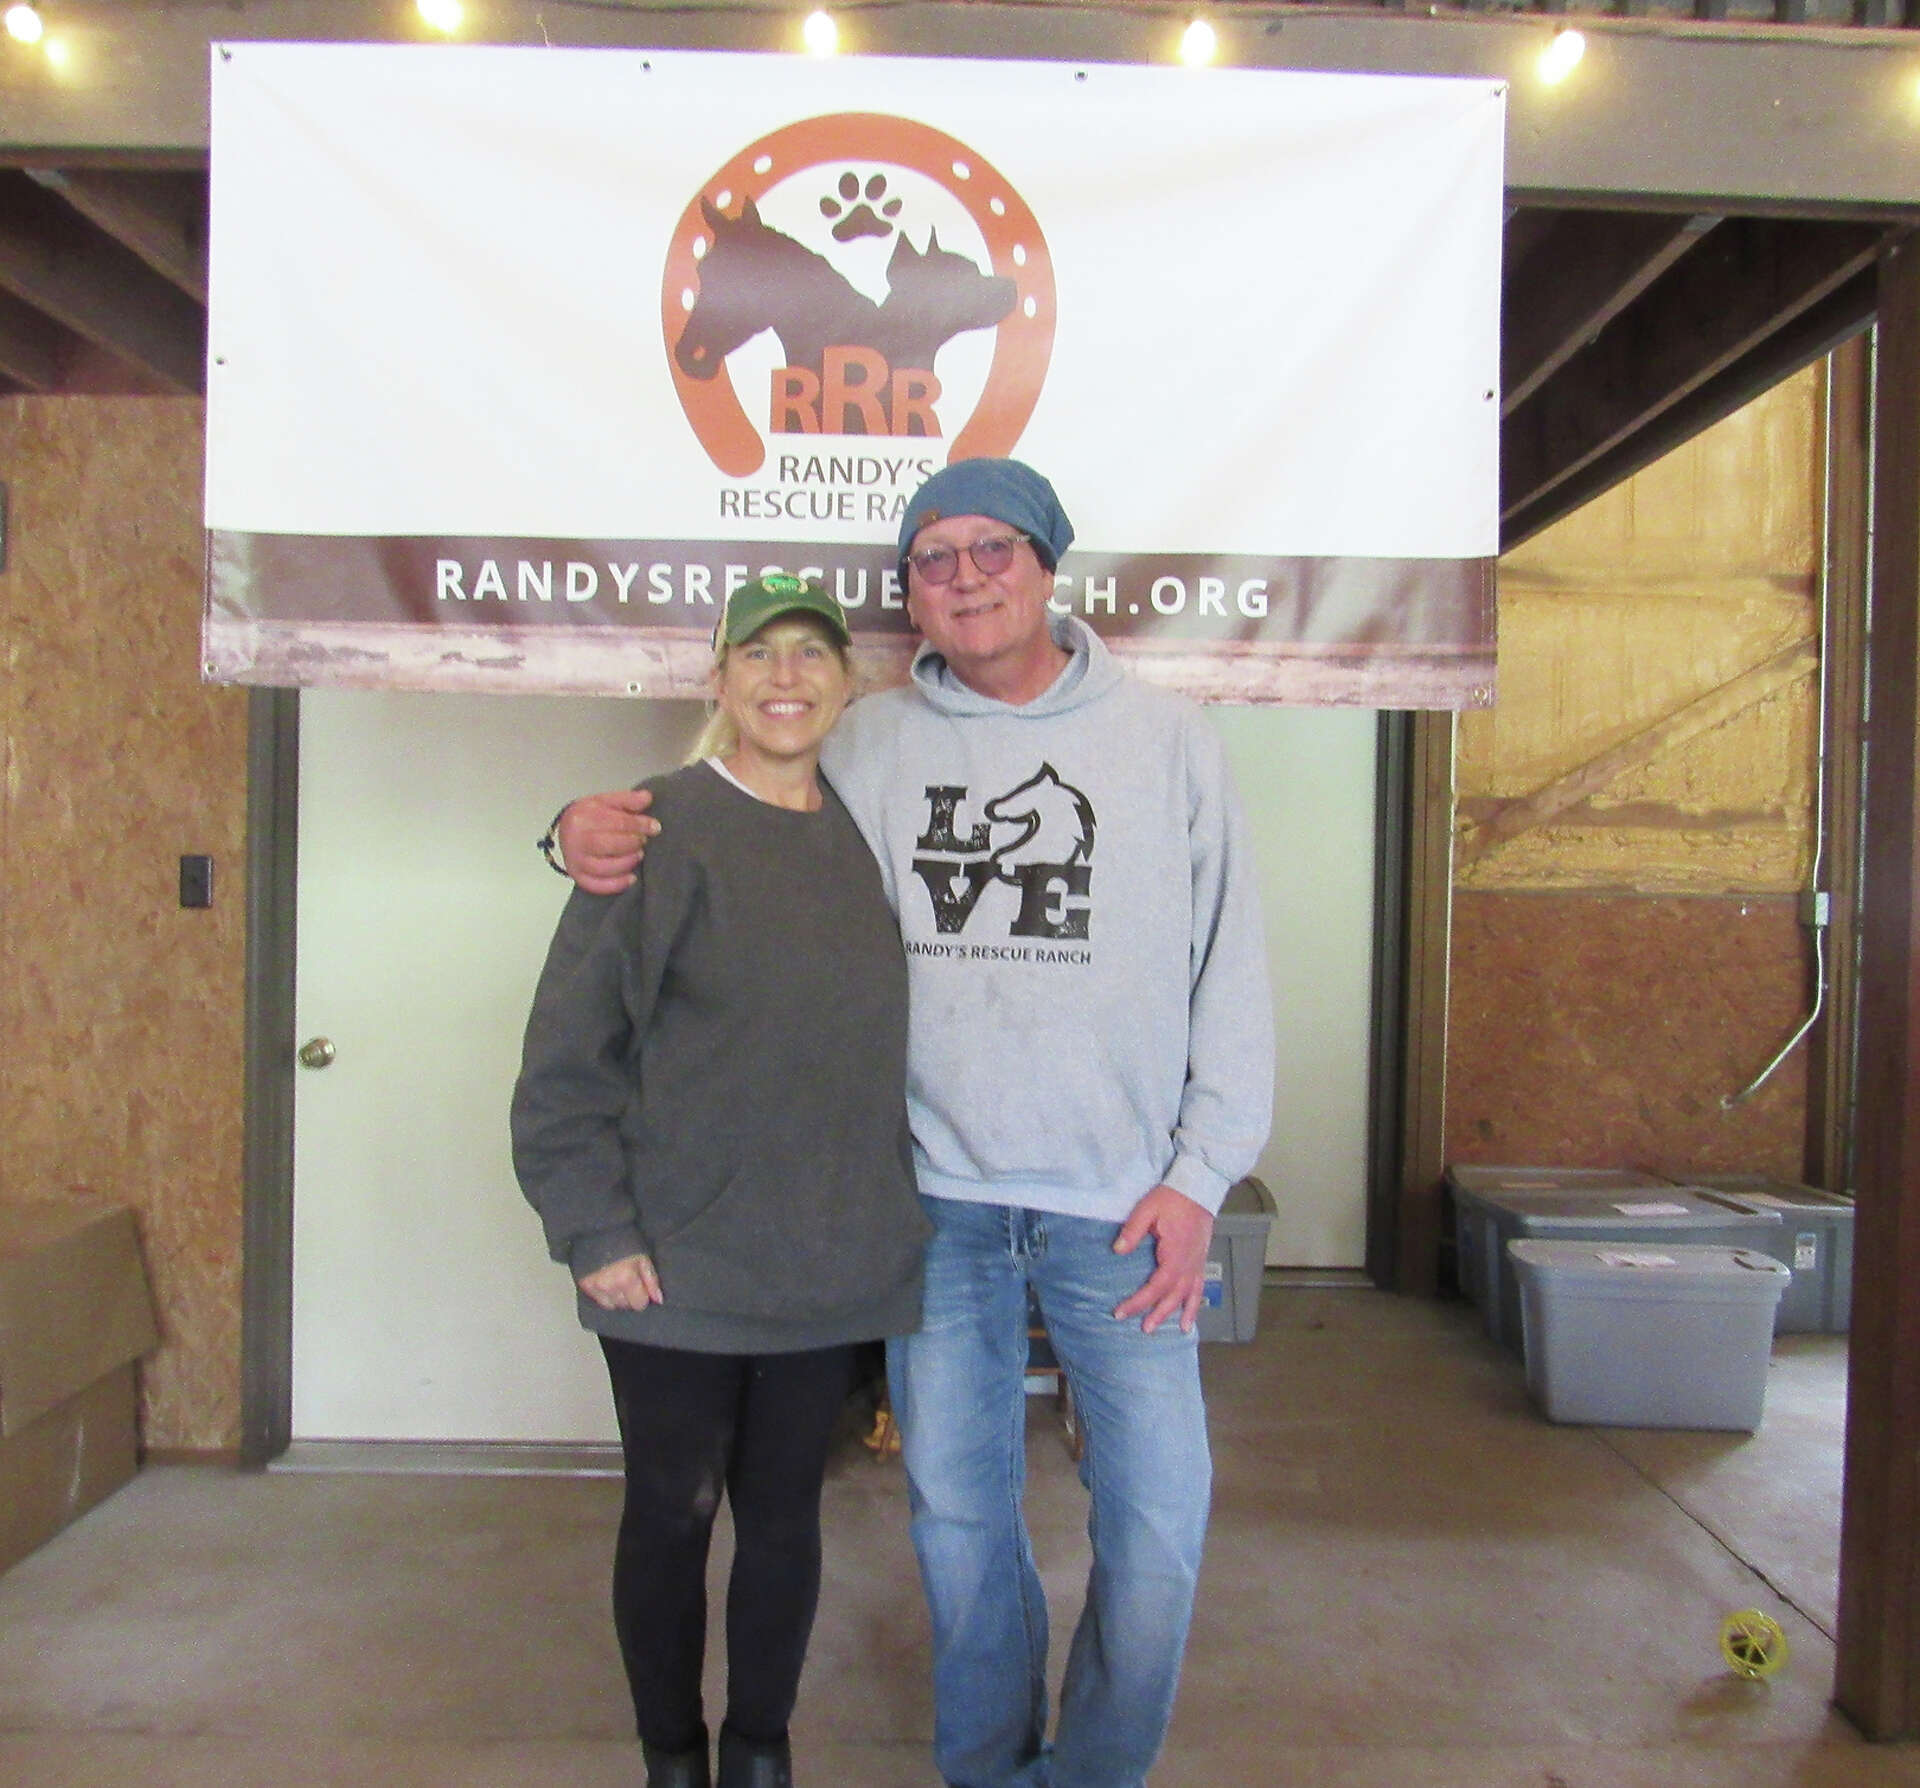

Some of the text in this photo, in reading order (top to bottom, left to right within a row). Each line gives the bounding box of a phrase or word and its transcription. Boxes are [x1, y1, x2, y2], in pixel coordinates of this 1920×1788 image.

[770, 345, 943, 438] RRR
[779, 455, 935, 487] RANDY'S
[720, 489, 855, 521] RESCUE
[971, 944, 1032, 962] RESCUE
[1036, 949, 1092, 965] RANCH
